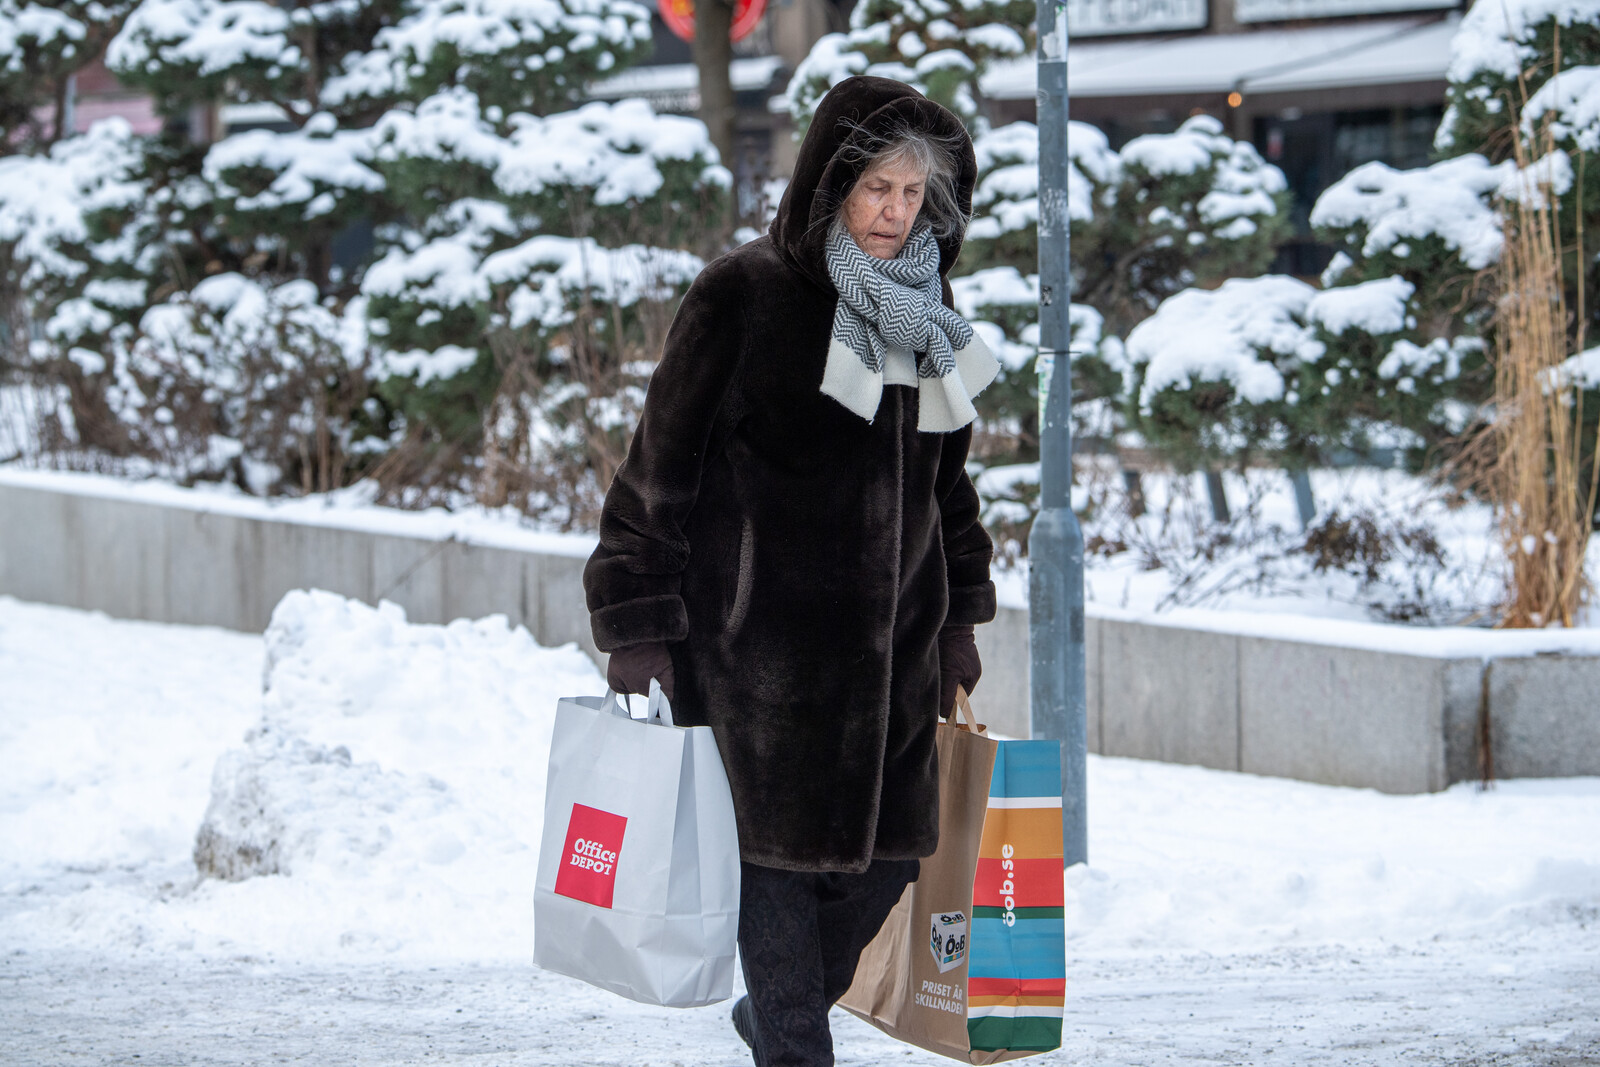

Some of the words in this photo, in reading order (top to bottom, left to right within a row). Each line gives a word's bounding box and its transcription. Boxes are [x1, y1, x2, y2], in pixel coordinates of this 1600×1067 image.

[574, 838, 616, 863] Office
[570, 853, 612, 875] DEPOT
[1000, 844, 1016, 928] öob.se
[940, 913, 965, 923] ÖoB
[945, 934, 966, 955] ÖoB
[922, 980, 952, 997] PRISET
[952, 984, 963, 1001] ÄR
[915, 992, 964, 1016] SKILLNADEN
